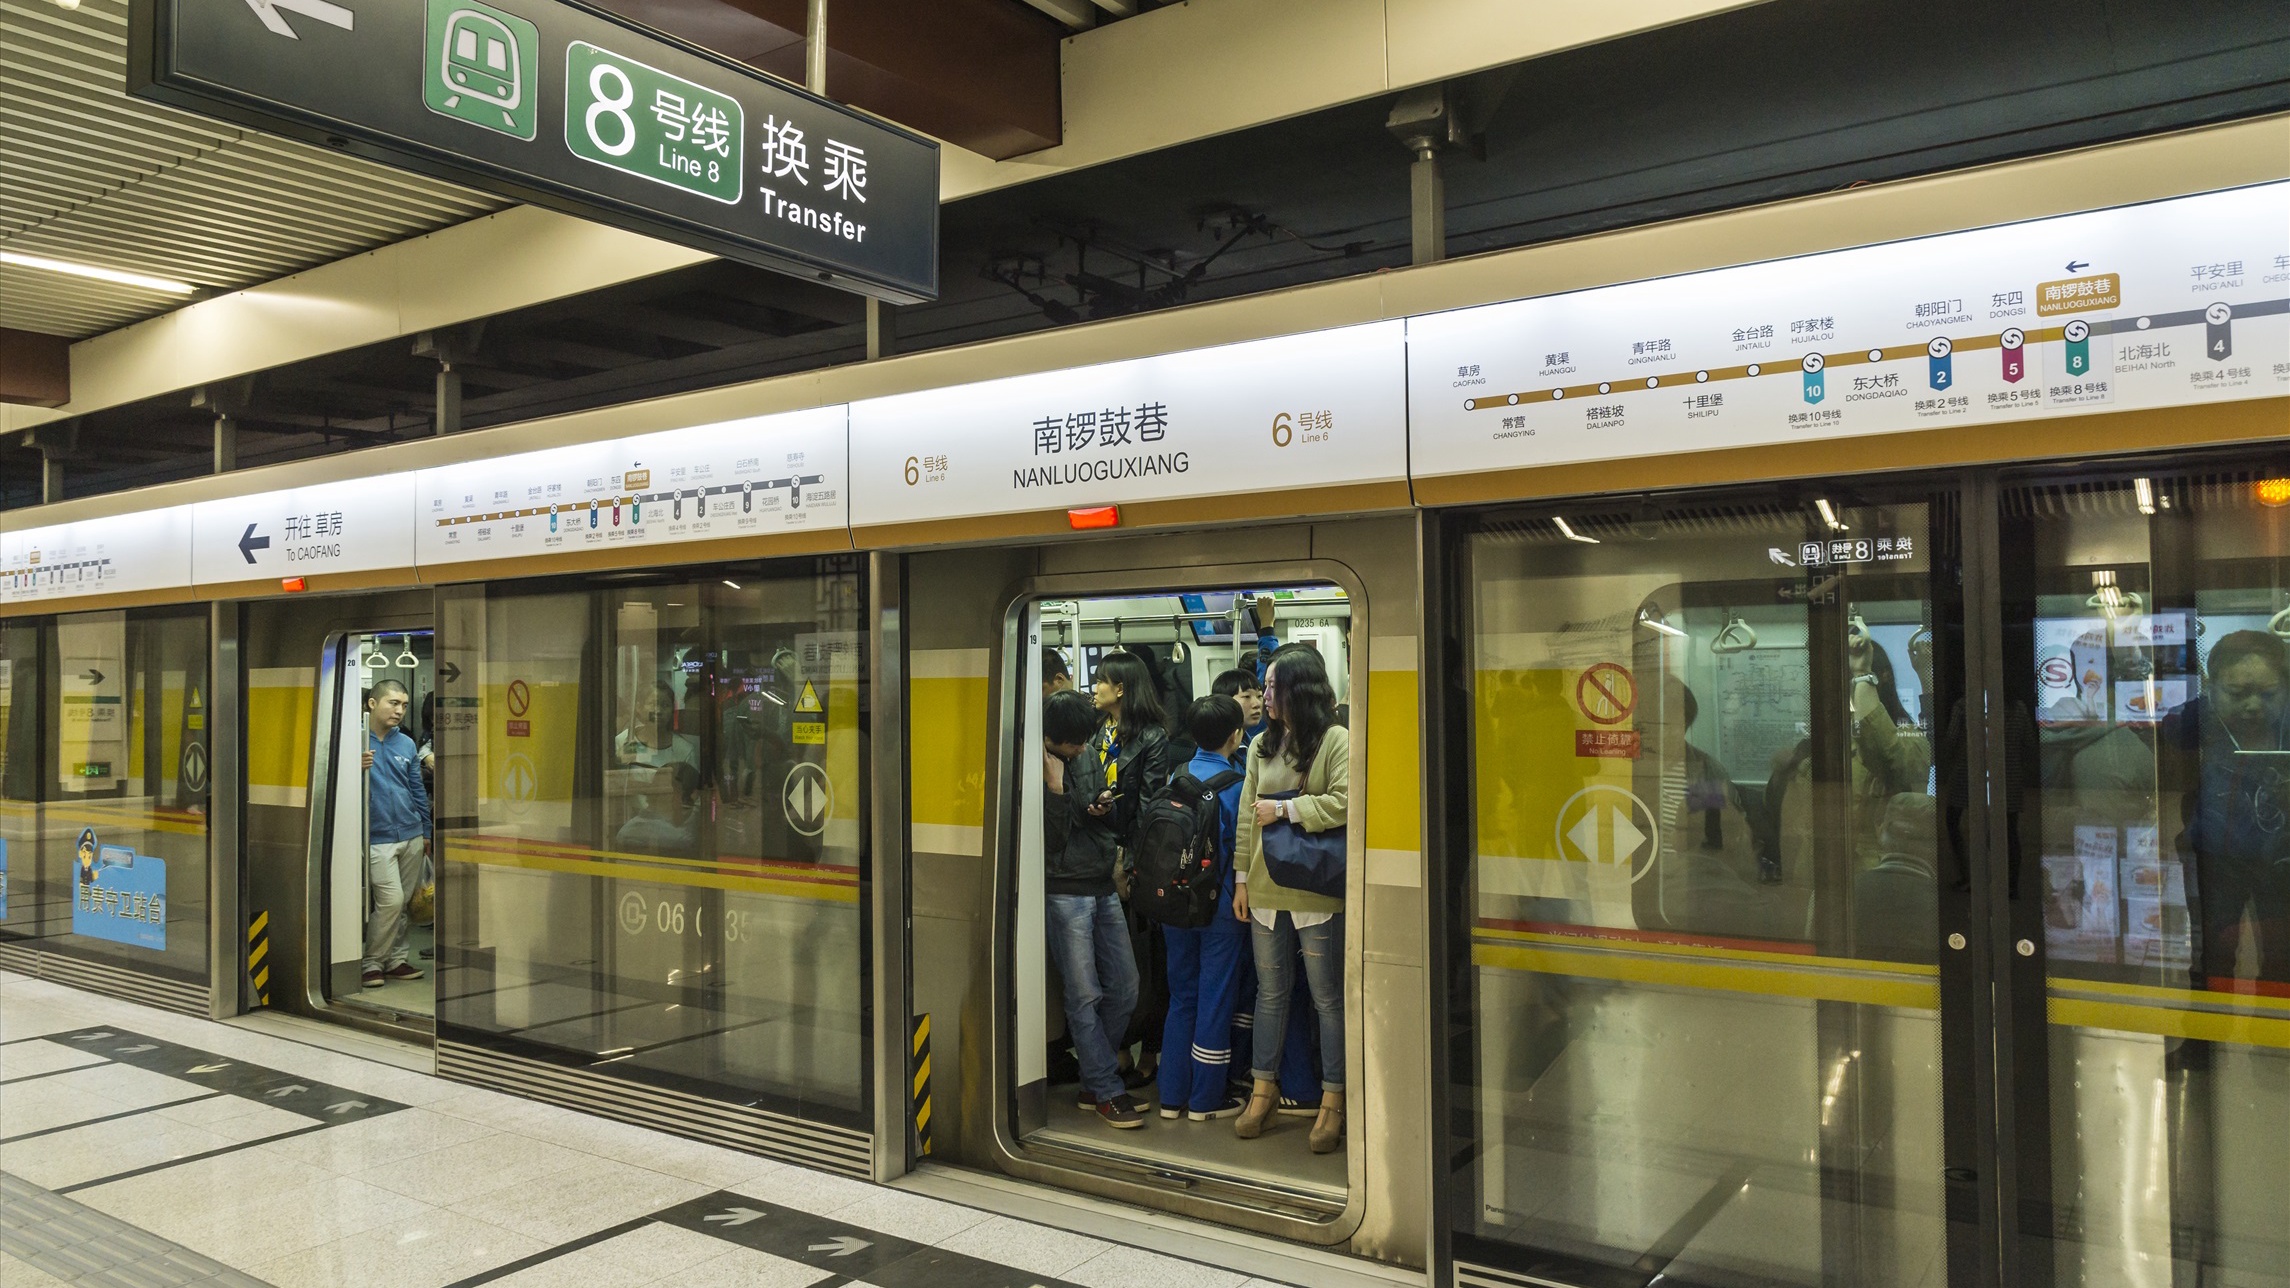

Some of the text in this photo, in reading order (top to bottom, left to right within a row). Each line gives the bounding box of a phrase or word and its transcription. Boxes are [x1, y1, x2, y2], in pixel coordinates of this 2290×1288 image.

[585, 63, 730, 158] 8 号线
[659, 144, 720, 183] Line 8
[760, 115, 868, 204] 换乘
[760, 187, 866, 244] Transfer
[2190, 261, 2244, 280] 平安里
[2045, 279, 2111, 300] 南锣鼓巷
[1992, 291, 2023, 308] 东四
[2040, 296, 2117, 313] NANLUOGUXIANG
[1915, 299, 1962, 317] 朝阳门
[1990, 308, 2026, 319] DONGSI
[1790, 316, 1834, 334] 呼家楼
[1906, 315, 1972, 329] CHAOYANGMEN
[1732, 325, 1774, 342] 金台路
[1791, 333, 1834, 344] HUJIALOU
[1632, 339, 1671, 355] 青年路
[1735, 341, 1771, 351] JINTAILU
[2119, 342, 2170, 361] 北海北
[2214, 340, 2224, 352] 4
[1545, 352, 1570, 367] 黄渠
[1628, 354, 1676, 365] QINGNIANLU
[2073, 356, 2082, 368] 8
[1457, 365, 1480, 377] 草房
[1539, 366, 1576, 376] HUANGQU
[2009, 363, 2019, 375] 5
[2115, 361, 2175, 373] BEIHAI North
[1453, 378, 1486, 388] CAOFANG
[1853, 373, 1899, 391] 东大桥
[1937, 372, 1946, 383] 2
[1806, 385, 1821, 397] 10
[1846, 389, 1908, 402] DONGDAQIAO
[1683, 393, 1724, 409] 十里堡
[1688, 410, 1719, 419] SHILIPU
[1033, 402, 1169, 456] 南锣鼓巷
[1271, 410, 1333, 447] 6 号线
[1502, 416, 1526, 429] 常营
[1587, 420, 1624, 430] DALIANPO
[1301, 432, 1328, 443] Line 6
[1493, 430, 1535, 440] CHANGYING
[904, 455, 949, 486] 6 号线
[925, 472, 945, 483] Line 6
[1013, 452, 1190, 490] NANLUOGUXIANG
[285, 511, 343, 542] 开往 草房
[286, 543, 341, 561] To CAOFANG
[1295, 619, 1329, 627] 0235 6A
[1030, 635, 1037, 644] 19
[657, 901, 684, 934] 06
